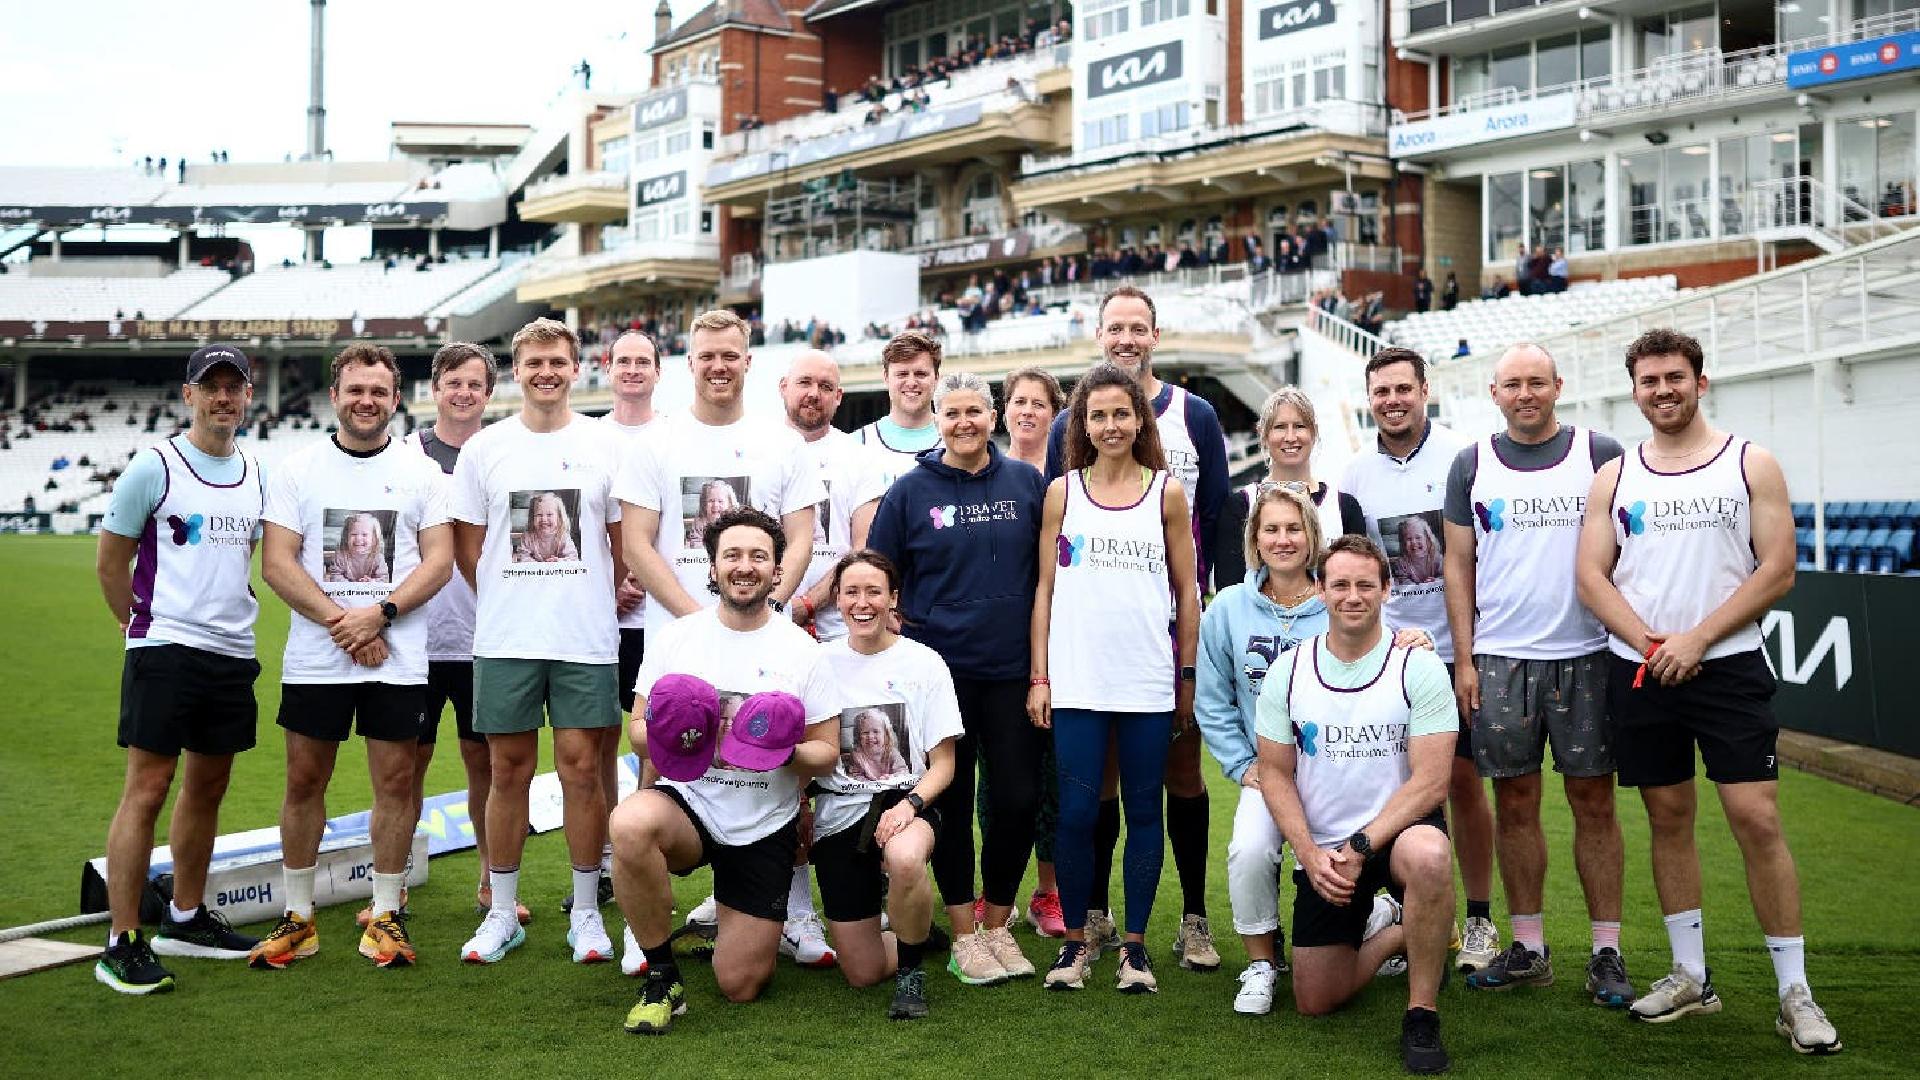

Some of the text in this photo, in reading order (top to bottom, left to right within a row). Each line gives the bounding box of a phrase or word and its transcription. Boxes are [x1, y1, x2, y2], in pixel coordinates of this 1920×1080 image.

[1486, 113, 1529, 131] Arora
[1395, 131, 1436, 149] Arora
[292, 319, 339, 335] STAND
[958, 500, 1017, 516] DRAVET
[1512, 496, 1587, 514] DRAVE
[1652, 497, 1744, 518] DRAVET
[209, 516, 252, 531] DRAV
[960, 513, 1003, 524] Sndrome
[1512, 515, 1577, 532] Syndrome
[1652, 517, 1719, 536] Syndrome
[1089, 537, 1165, 562] DRAVET
[1089, 554, 1145, 571] Syndrome
[1325, 723, 1410, 743] DRAVET
[1325, 744, 1390, 763] Syndrome
[217, 882, 272, 907] Home
